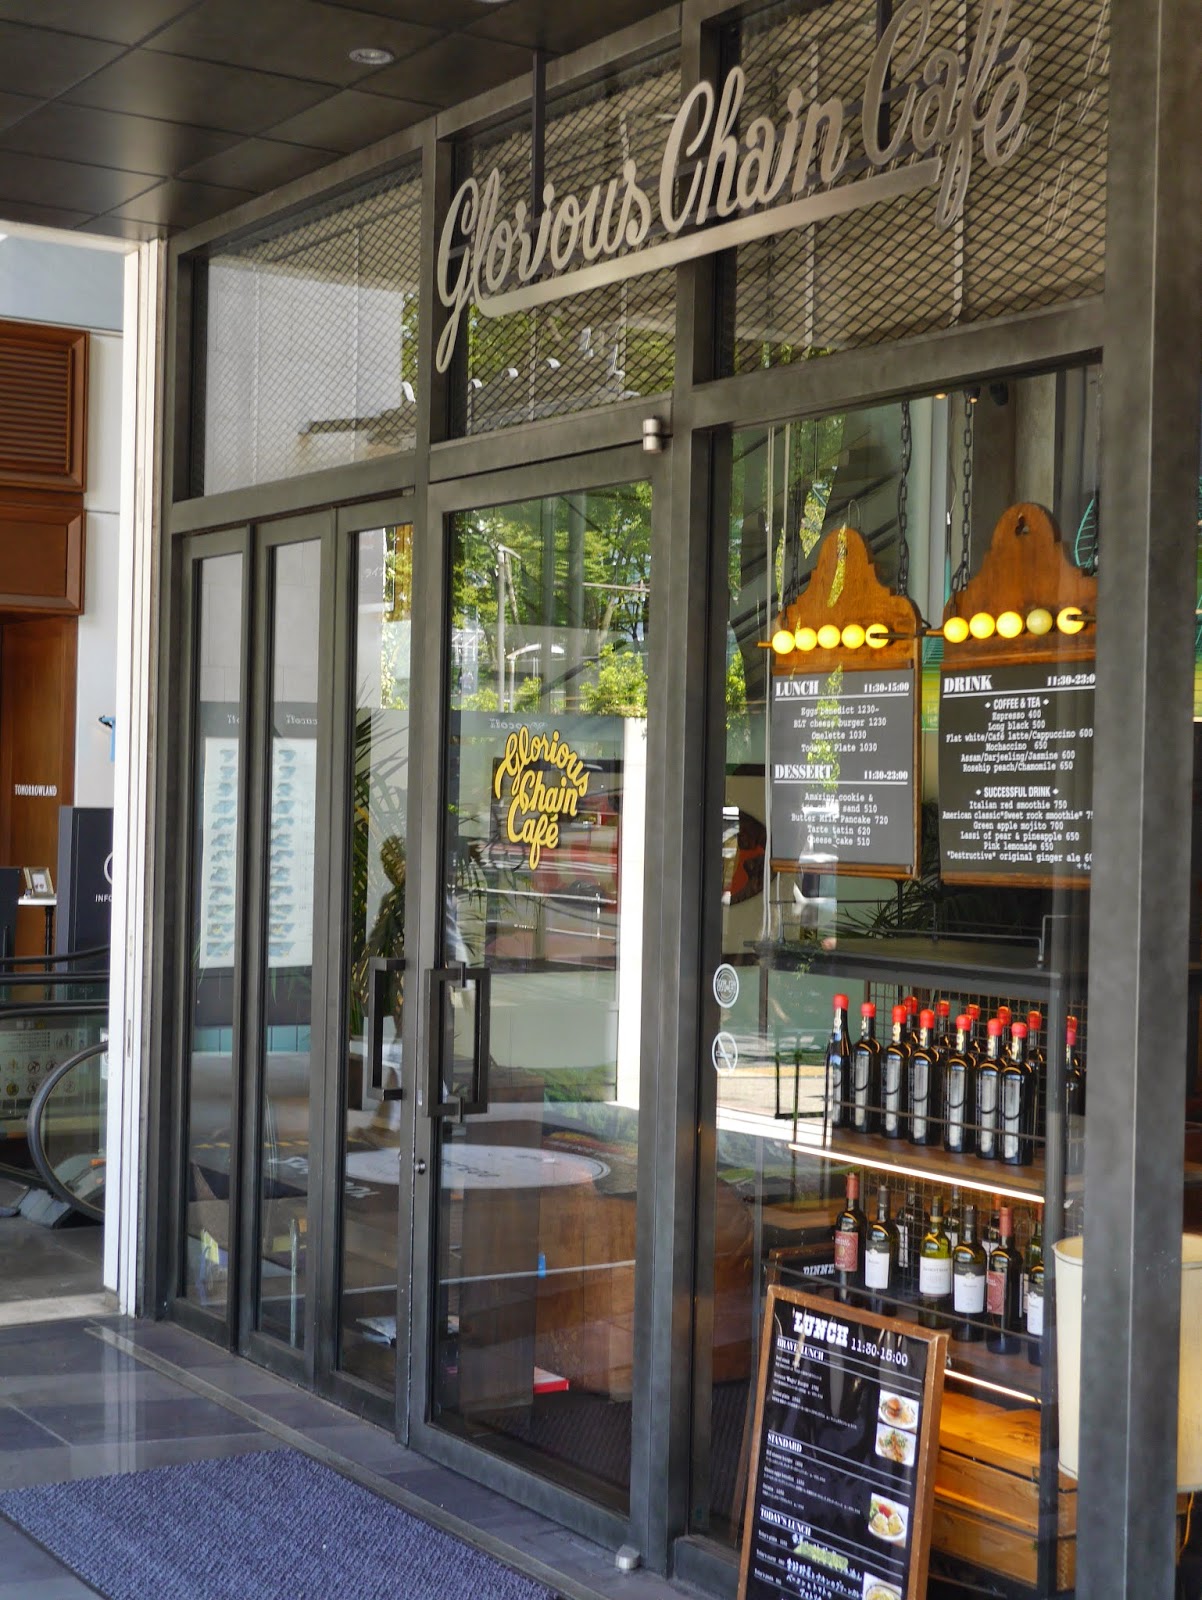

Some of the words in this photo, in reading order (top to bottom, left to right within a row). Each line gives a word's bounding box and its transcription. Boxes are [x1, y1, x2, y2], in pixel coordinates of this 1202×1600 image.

[435, 160, 651, 374] Glorious
[659, 65, 850, 234] Chain
[862, 0, 1032, 231] Café
[775, 680, 819, 696] LUNCH
[864, 682, 909, 693] 11:30-15:00
[944, 675, 992, 693] DRINK
[1047, 673, 1096, 686] 11:30-23:0
[993, 697, 1019, 710] COFFEE
[1020, 697, 1026, 709] &
[1027, 697, 1041, 708] TEA
[992, 711, 1025, 722] Espresso
[1028, 710, 1041, 719] 400
[793, 719, 806, 728] BLT
[838, 718, 865, 729] burger
[869, 717, 887, 726] 1230
[988, 722, 1005, 732] Long
[1007, 721, 1029, 730] black
[1032, 720, 1046, 729] 500
[811, 731, 846, 740] Omelette
[849, 730, 867, 739] 1030
[946, 733, 962, 743] Flat
[1008, 729, 1076, 741] latte/Cappuccino
[1079, 728, 1094, 738] 600
[834, 743, 856, 752] Plate
[860, 743, 878, 752] 1030
[986, 742, 1027, 752] Mochaccino
[1034, 741, 1048, 750] 650
[494, 725, 590, 799] Glorious
[960, 750, 1058, 763] Assam/Darjeeling/Jasmine
[1061, 750, 1076, 760] 600
[774, 764, 834, 779] DESSERT
[864, 770, 908, 780] 11:30-23:00
[963, 763, 991, 773] Rosehip
[994, 761, 1056, 774] peach/Chamomile
[1060, 761, 1073, 771] 650
[15, 784, 58, 797] TOMORROWLAND
[519, 769, 578, 817] Chain
[984, 787, 1027, 798] SUCCESSFUL
[1028, 786, 1051, 797] DRINK
[805, 792, 836, 803] Amazing
[839, 793, 865, 802] cookie
[842, 805, 860, 813] sand
[864, 804, 878, 813] 510
[969, 800, 997, 809] Italian
[1000, 800, 1013, 809] red
[1016, 800, 1051, 809] smoothie
[1054, 799, 1067, 809] 750
[791, 813, 816, 823] Butter
[840, 815, 871, 825] Pancake
[875, 816, 889, 825] 720
[942, 811, 972, 820] American
[1026, 811, 1042, 820] rock
[507, 794, 560, 871] Café
[807, 825, 829, 834] Tarte
[832, 825, 854, 835] tatin
[857, 826, 871, 835] 620
[973, 821, 994, 830] Green
[997, 821, 1018, 832] apple
[1020, 821, 1047, 832] mojito
[1050, 821, 1064, 830] 700
[836, 836, 854, 845] cake
[857, 837, 871, 846] 510
[960, 831, 980, 840] Lassi
[983, 831, 992, 840] of
[995, 832, 1012, 842] pear
[1015, 832, 1020, 840] &
[1023, 832, 1062, 843] pineapple
[1065, 832, 1080, 841] 650
[984, 842, 1000, 850] Pink
[1004, 842, 1037, 851] lemonade
[1040, 842, 1054, 851] 650
[1000, 852, 1033, 863] original
[1036, 853, 1063, 863] ginger
[1066, 853, 1081, 862] ale
[803, 1264, 835, 1276] DINNE
[793, 1311, 849, 1348] LUNCH
[851, 1338, 908, 1366] 11:30-15:00
[800, 1345, 824, 1361] LUNCH
[767, 1433, 802, 1453] STANDARD
[760, 1508, 787, 1527] TODAY'S
[787, 1518, 811, 1536] LUNCH
